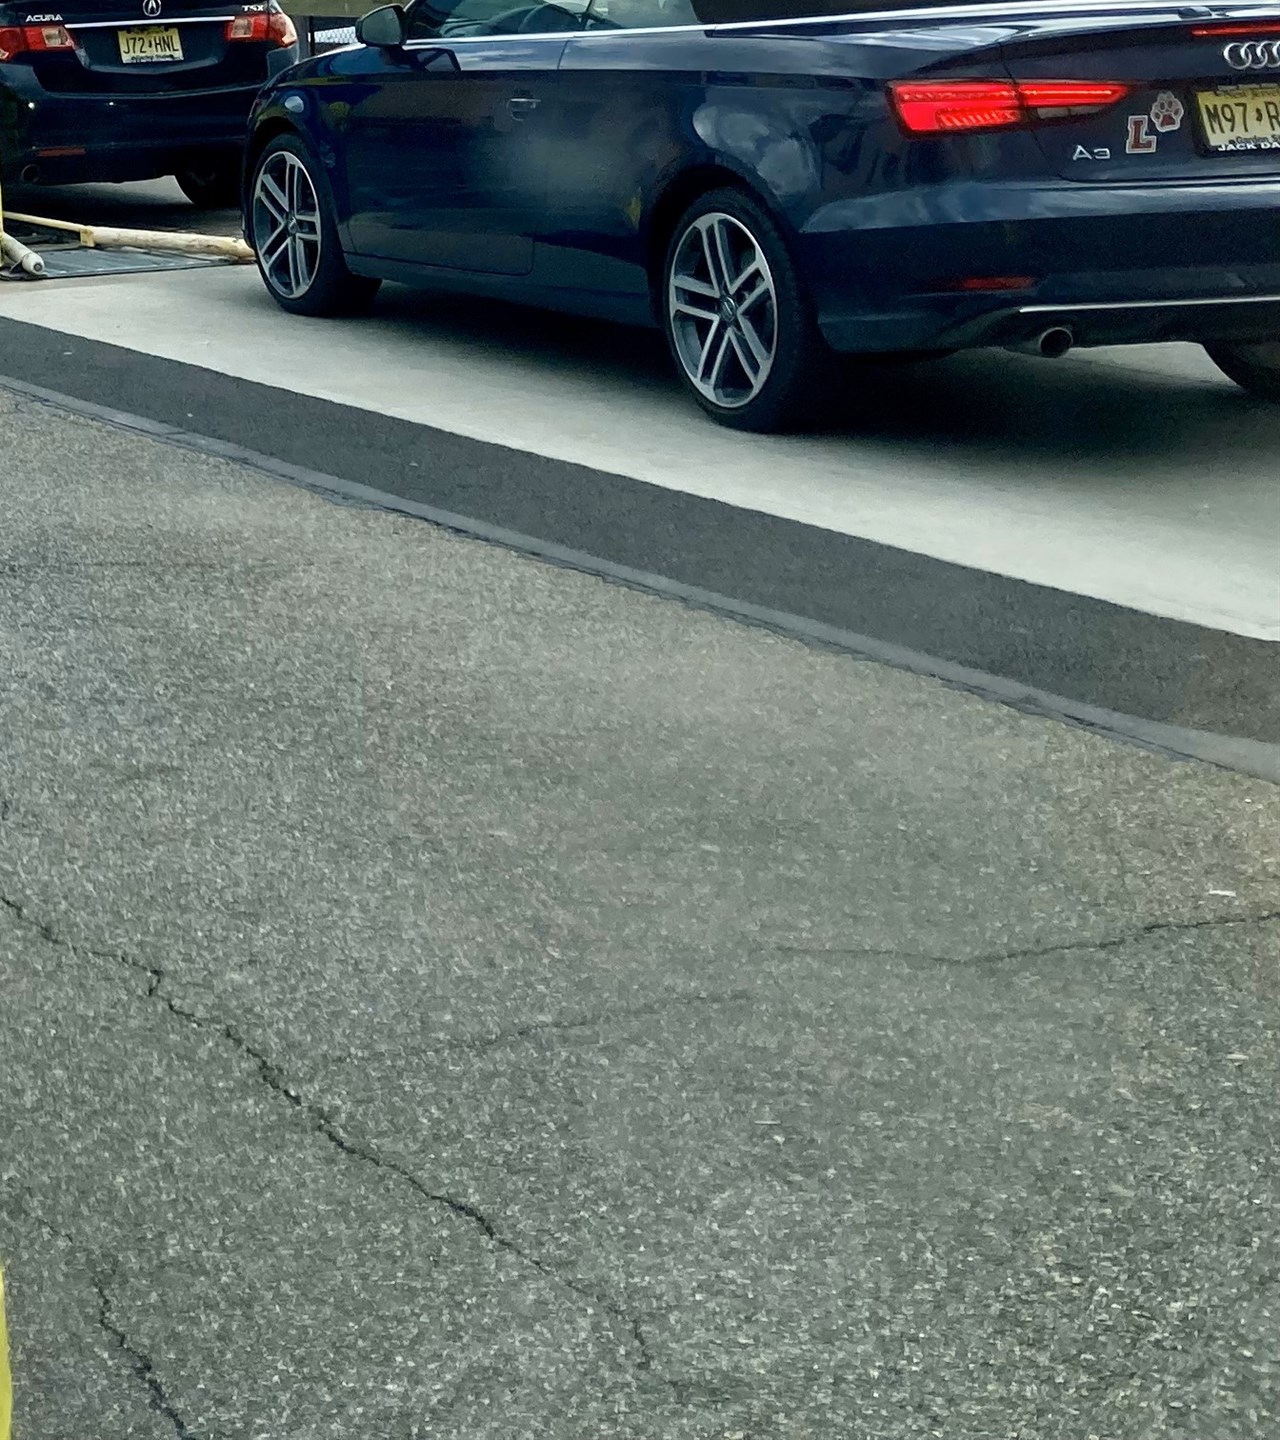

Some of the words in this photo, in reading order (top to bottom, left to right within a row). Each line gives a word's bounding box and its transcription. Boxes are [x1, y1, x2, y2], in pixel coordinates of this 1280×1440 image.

[25, 14, 63, 22] ACURA
[1217, 143, 1257, 151] JACK
[1073, 145, 1111, 160] A3
